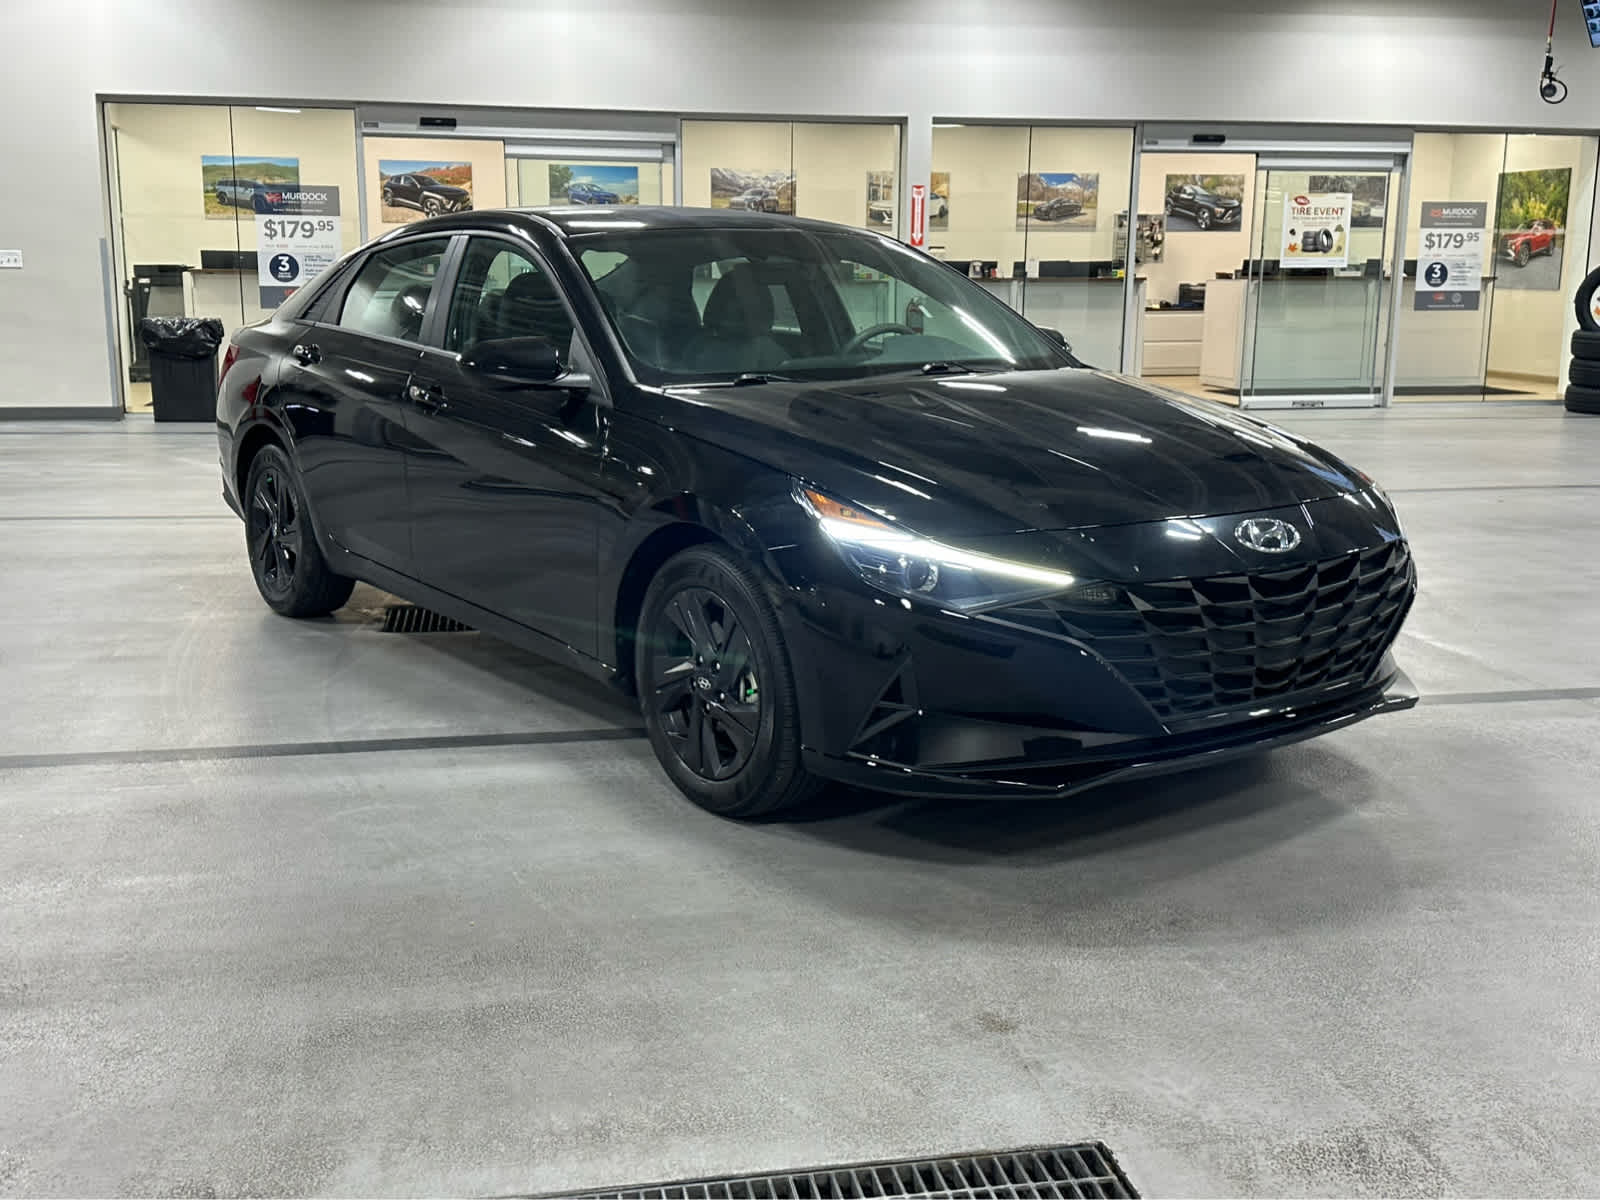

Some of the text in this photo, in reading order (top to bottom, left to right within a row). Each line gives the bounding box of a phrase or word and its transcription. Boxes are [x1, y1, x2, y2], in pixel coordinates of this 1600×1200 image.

[282, 192, 327, 200] MURDOCK
[1291, 207, 1345, 217] TIRE EVENT
[264, 219, 334, 240] $179.95
[278, 256, 290, 272] 3
[1431, 264, 1442, 278] 3
